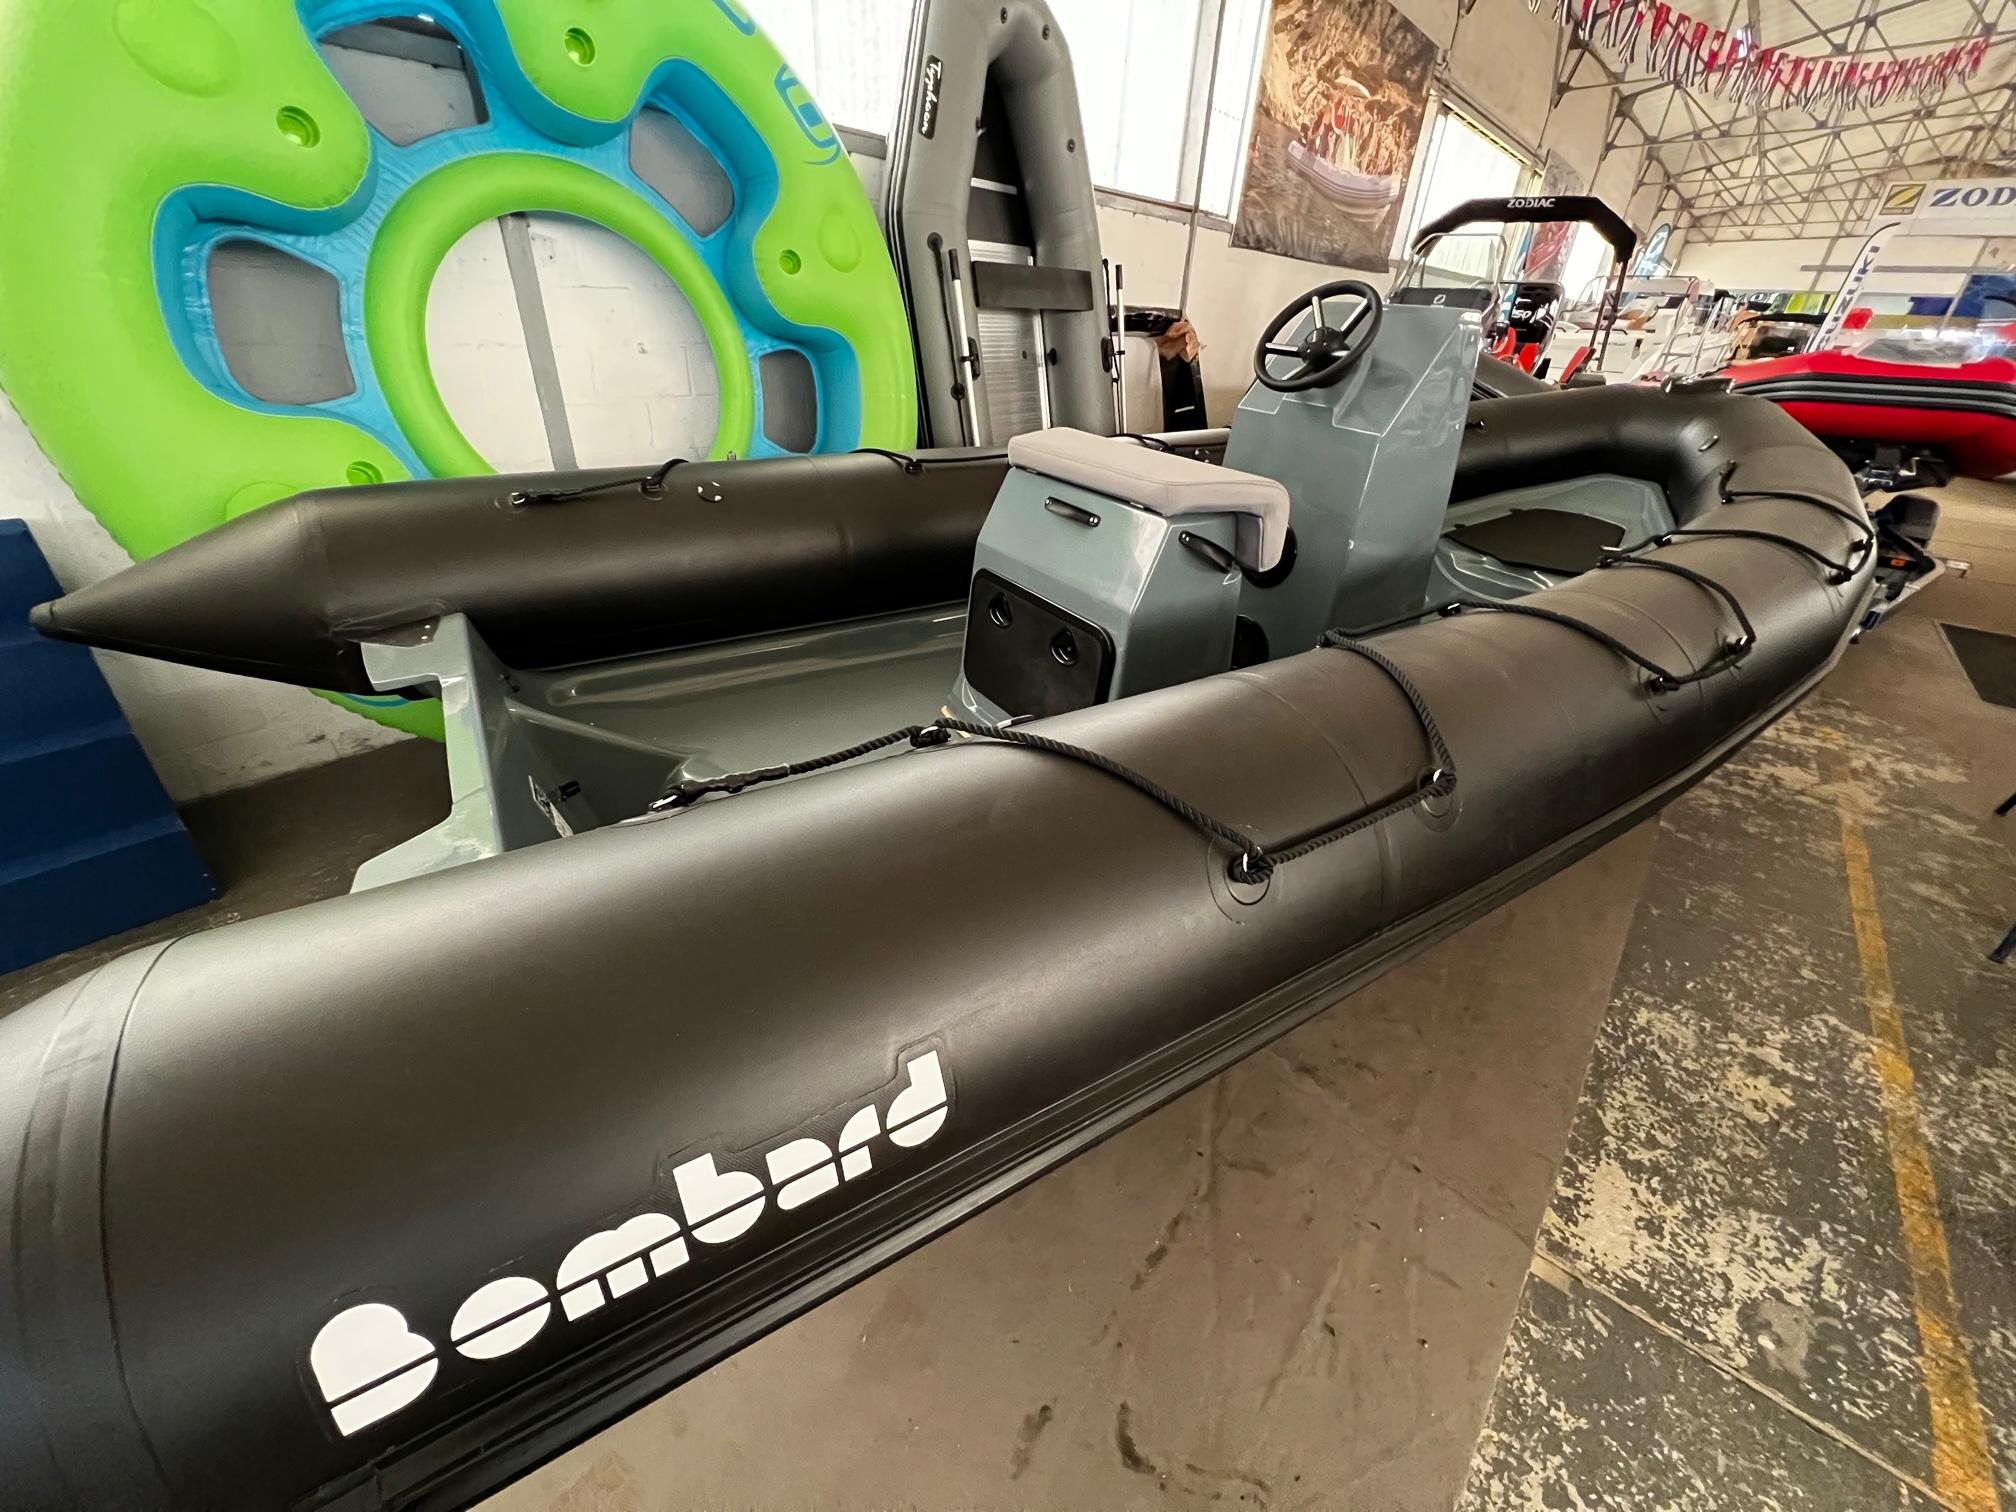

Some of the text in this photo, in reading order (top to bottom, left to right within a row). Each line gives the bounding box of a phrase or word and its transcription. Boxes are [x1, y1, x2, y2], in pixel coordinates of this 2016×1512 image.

[922, 61, 942, 134] Typhoon
[1507, 198, 1556, 208] ZODIAC
[310, 1050, 949, 1437] Bombard
